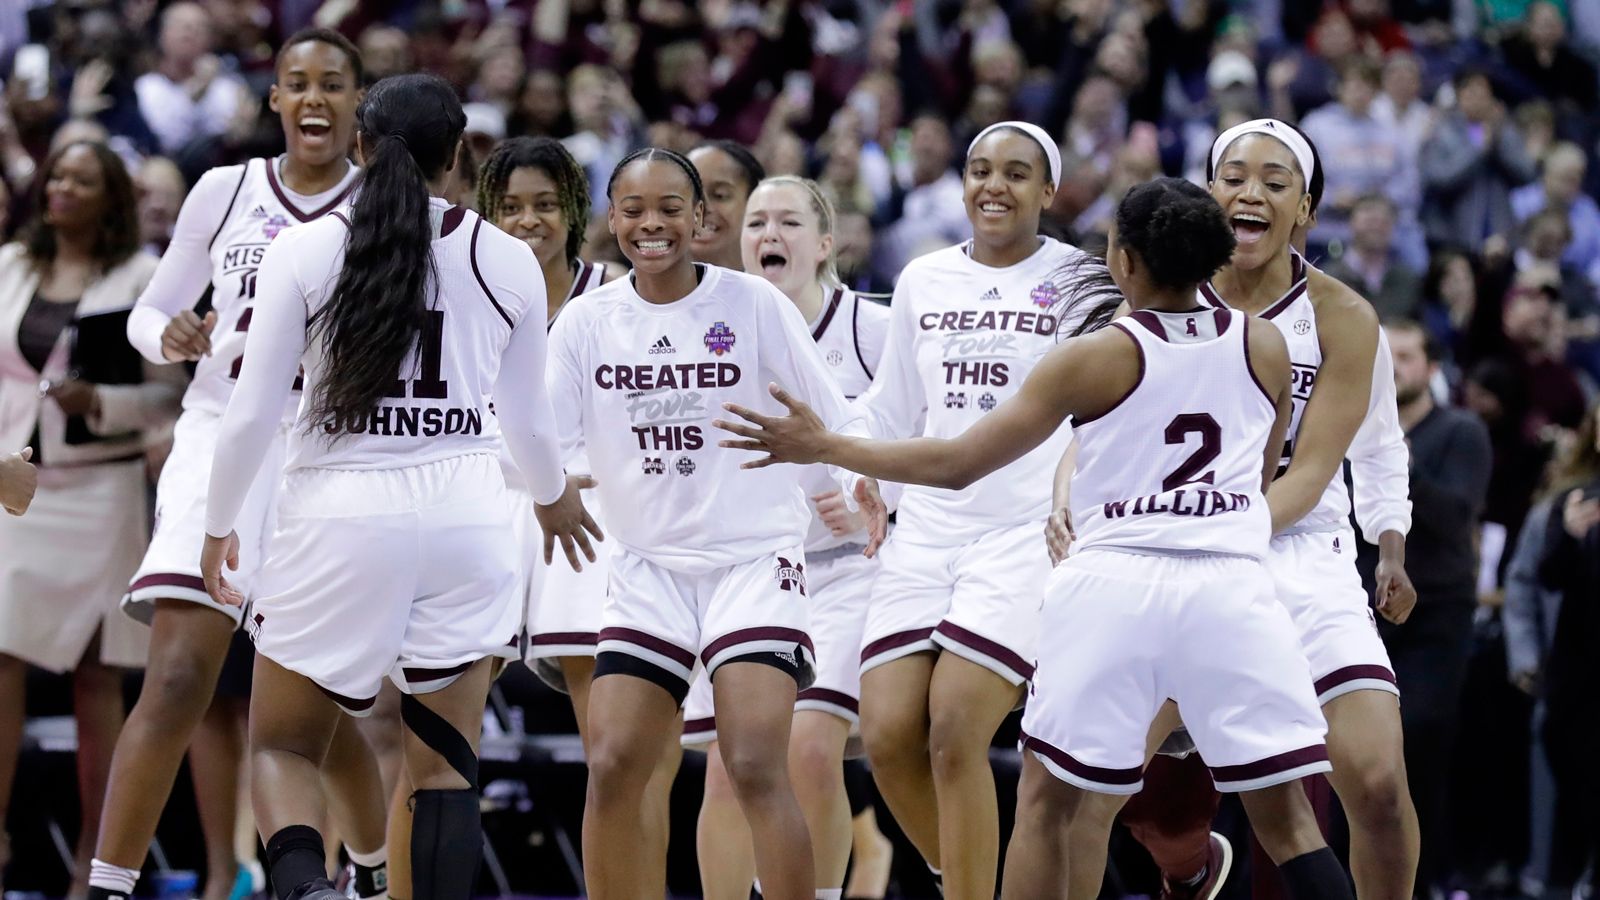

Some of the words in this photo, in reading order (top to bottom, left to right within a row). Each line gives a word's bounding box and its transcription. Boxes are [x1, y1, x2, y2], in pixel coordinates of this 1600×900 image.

[919, 310, 1057, 337] CREATED
[648, 347, 677, 355] adidas
[941, 333, 1019, 358] FOUR
[595, 362, 741, 390] CREATED
[942, 361, 1009, 387] THIS
[626, 391, 708, 422] FOUR
[324, 406, 482, 437] JOHNSON
[632, 425, 704, 451] THIS
[1162, 412, 1222, 493] 2
[1104, 489, 1250, 519] WILLIAM
